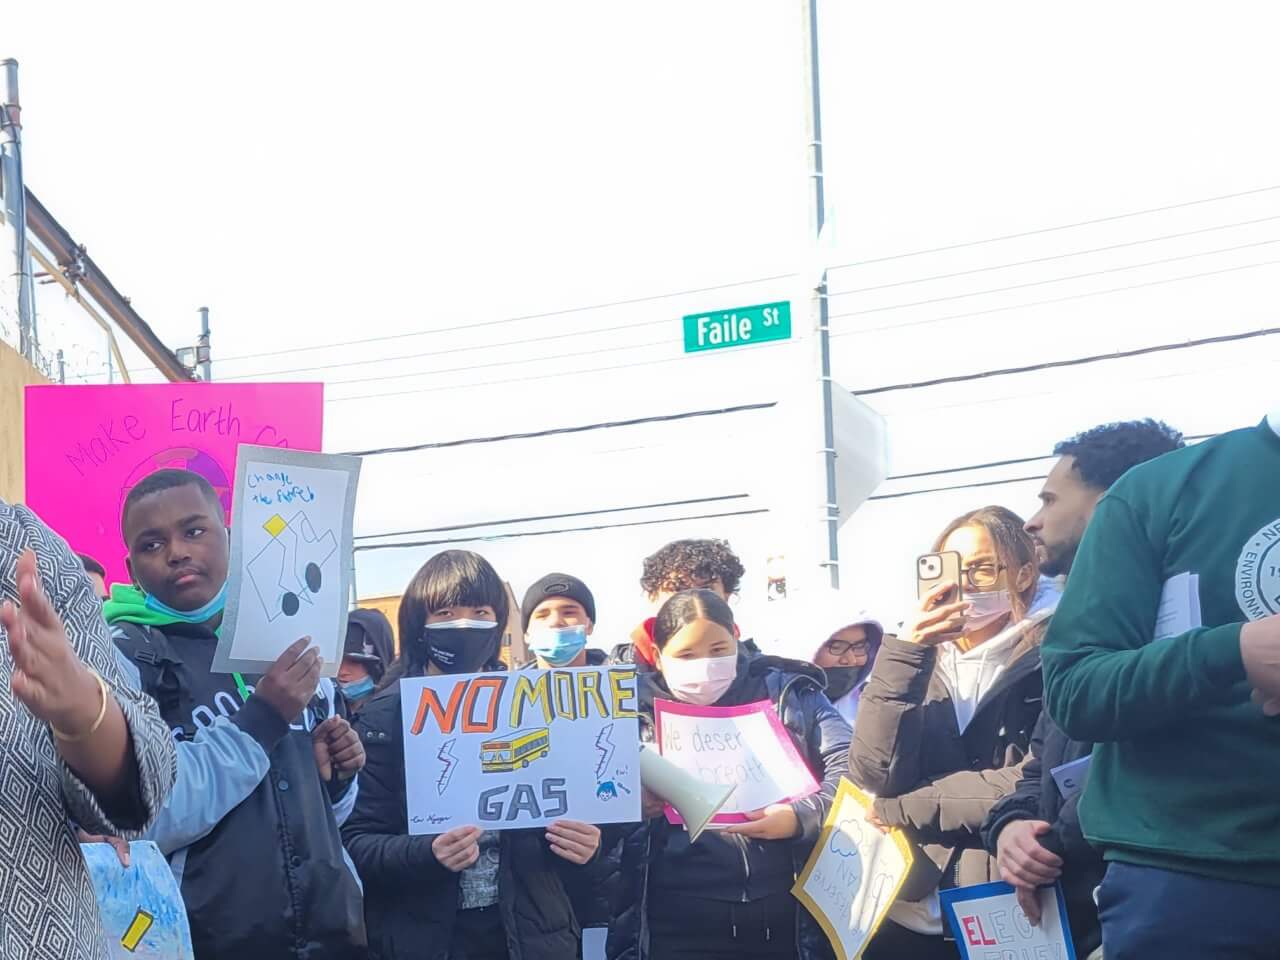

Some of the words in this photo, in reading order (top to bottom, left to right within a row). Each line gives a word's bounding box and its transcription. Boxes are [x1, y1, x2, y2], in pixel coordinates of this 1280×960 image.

[697, 314, 752, 346] Faile
[762, 307, 780, 327] St
[65, 415, 146, 477] Make
[171, 398, 241, 437] Earth
[1240, 551, 1266, 621] ENVIRONM
[410, 675, 509, 736] NO
[508, 668, 640, 729] MORE
[691, 721, 743, 753] deser
[477, 778, 569, 822] GAS
